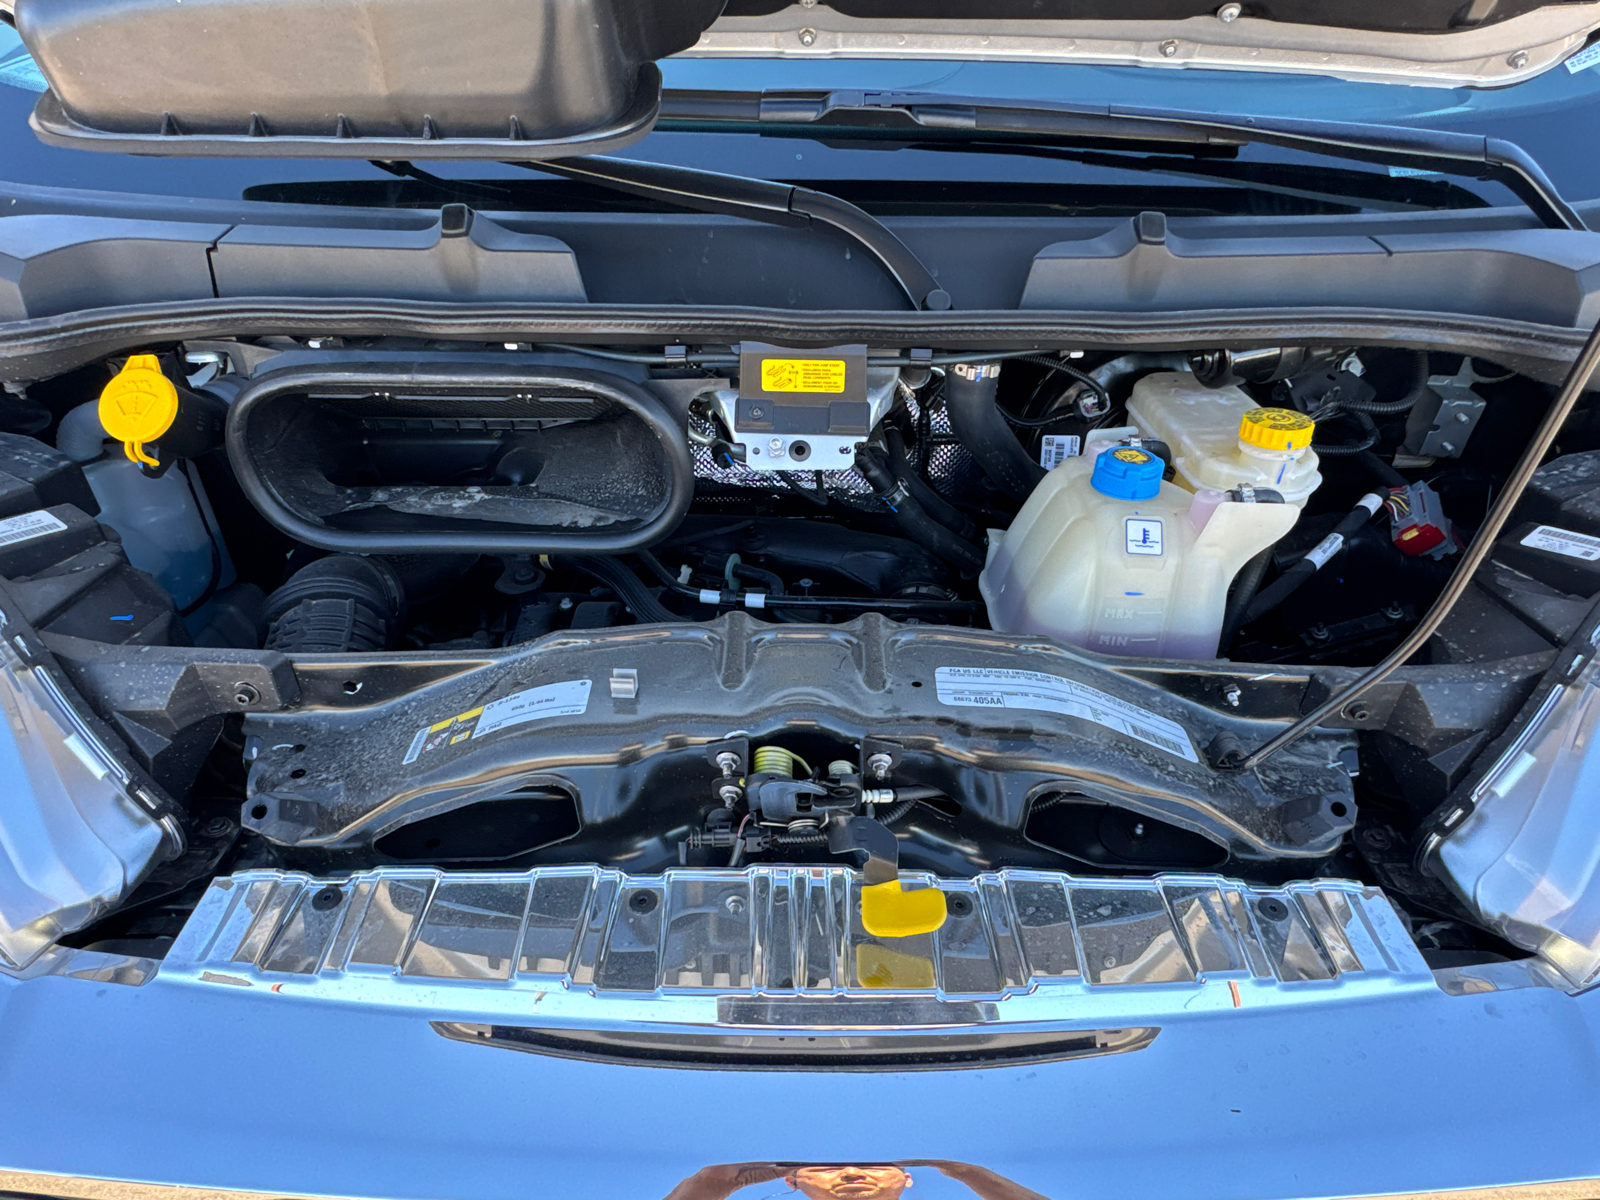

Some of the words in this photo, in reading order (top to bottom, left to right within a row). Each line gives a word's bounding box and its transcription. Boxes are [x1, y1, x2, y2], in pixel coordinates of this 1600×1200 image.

[1104, 608, 1135, 619] MAX
[1099, 635, 1129, 647] MIN
[1011, 670, 1039, 678] EMISSION
[1039, 673, 1064, 683] CONTROL
